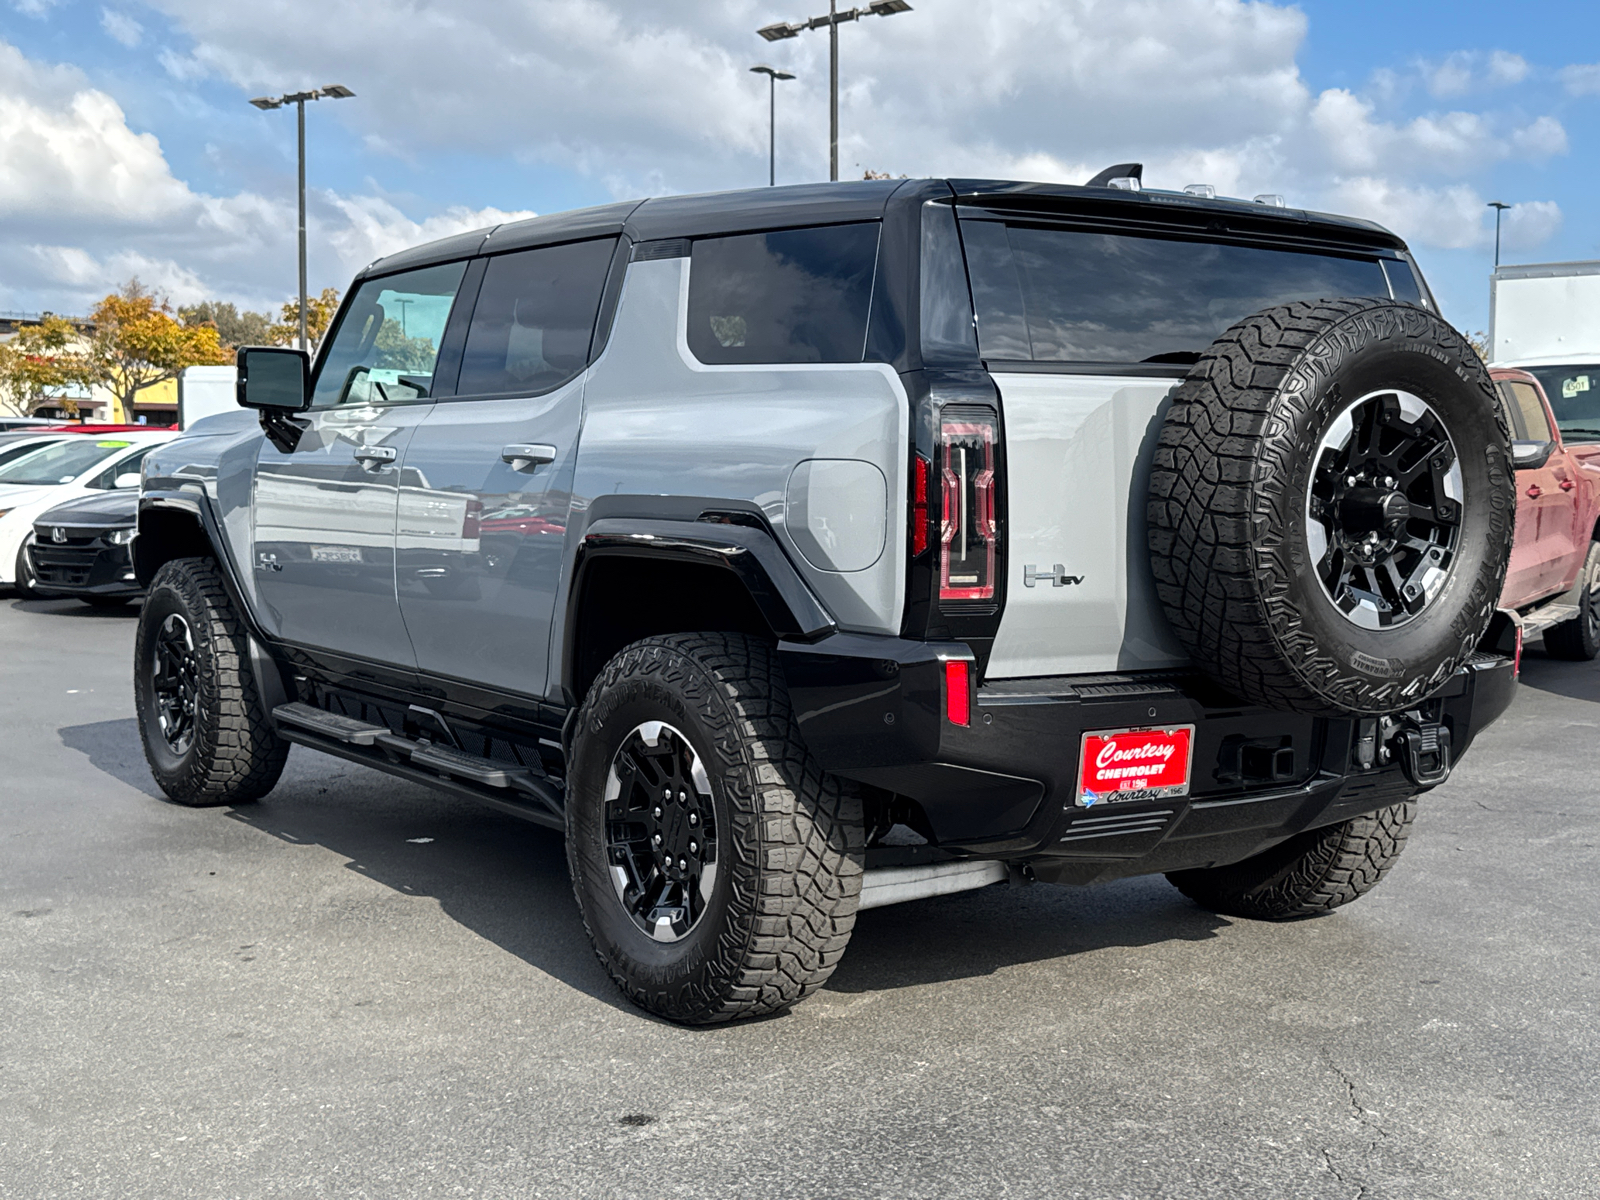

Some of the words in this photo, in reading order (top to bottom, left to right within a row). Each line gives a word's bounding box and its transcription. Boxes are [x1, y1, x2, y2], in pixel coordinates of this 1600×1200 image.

[1392, 342, 1451, 365] TERRITORY
[1449, 443, 1505, 639] GOODYEAR
[1353, 658, 1389, 676] DURAWALL
[1096, 742, 1175, 768] Courtesy
[1096, 763, 1166, 780] CHEVROLET
[1107, 788, 1162, 802] Courtesy
